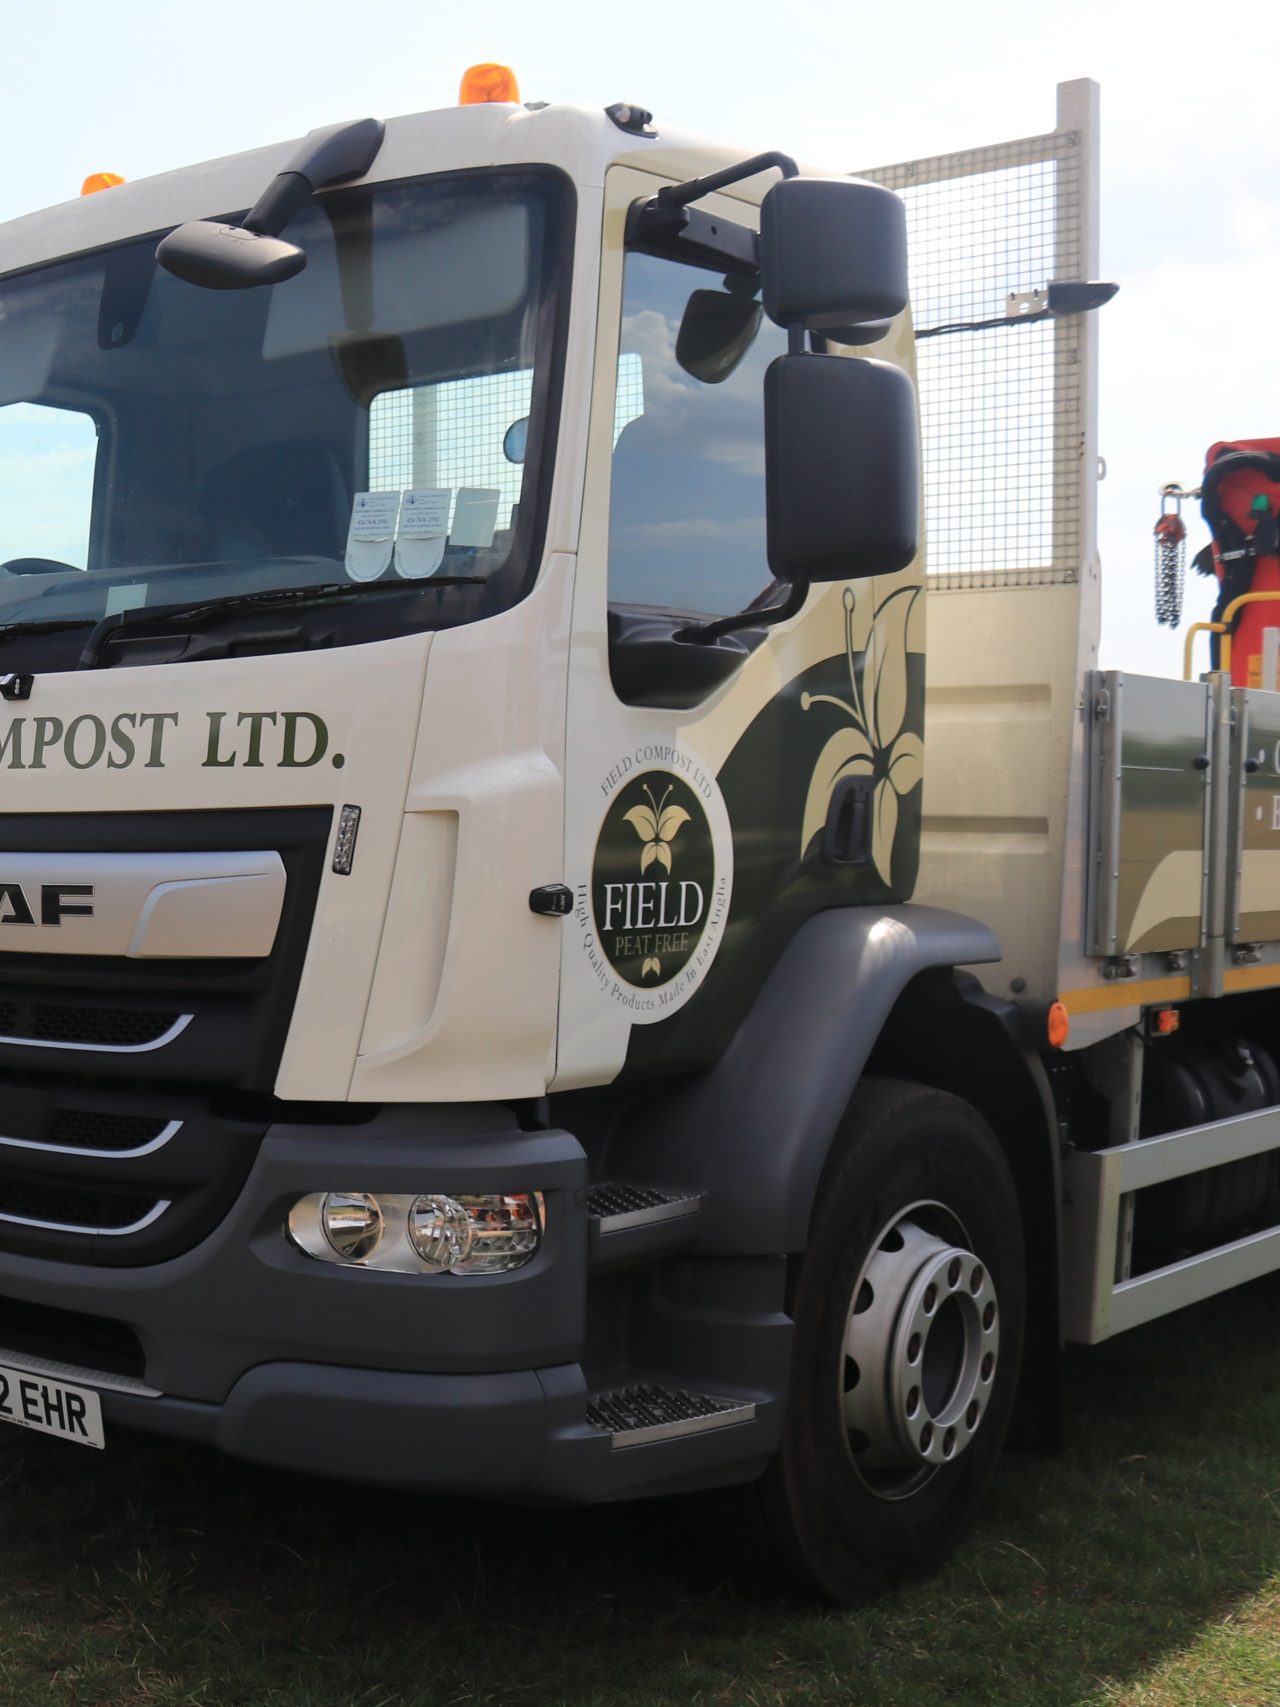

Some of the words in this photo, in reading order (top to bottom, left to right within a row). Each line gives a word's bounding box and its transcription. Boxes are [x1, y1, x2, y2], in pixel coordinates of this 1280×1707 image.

[201, 711, 345, 770] LTD.
[600, 755, 632, 797] FIELD
[635, 745, 694, 773] COMPOST
[693, 770, 713, 799] LTD
[602, 881, 704, 931] FIELD
[574, 884, 588, 929] High
[584, 933, 610, 992] Quality
[610, 985, 656, 1011] Products
[657, 981, 686, 1008] Made
[686, 968, 697, 985] In
[697, 935, 714, 969] East
[710, 876, 727, 931] Anglia
[615, 933, 652, 956] PEAT
[655, 932, 689, 953] FREE
[19, 1379, 89, 1438] EHR
